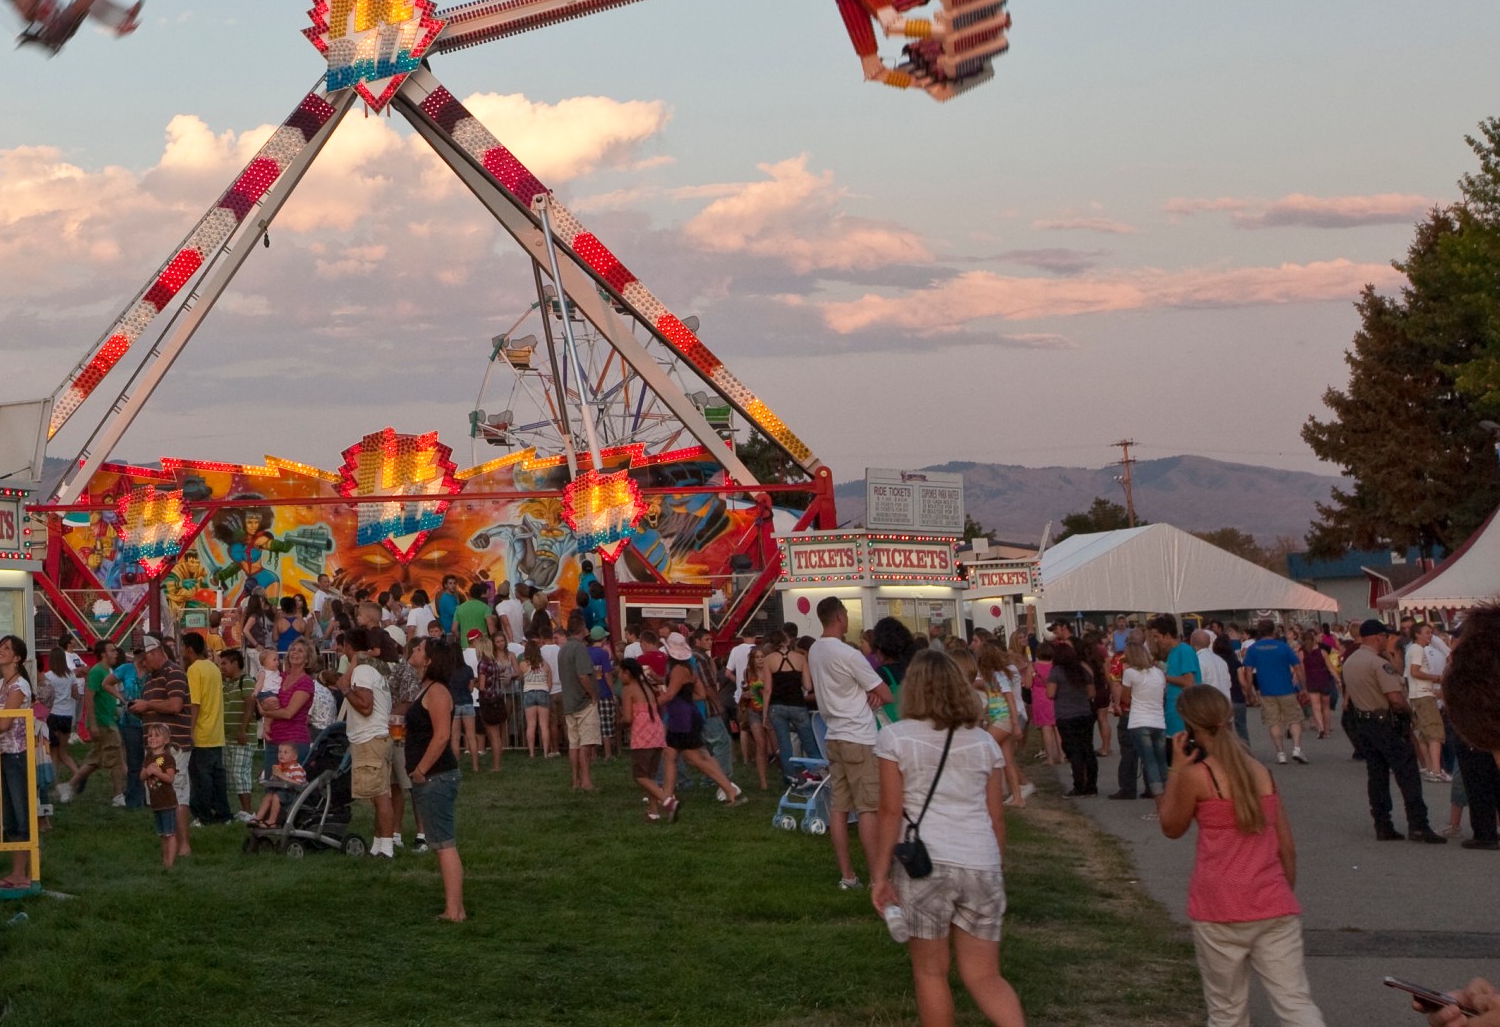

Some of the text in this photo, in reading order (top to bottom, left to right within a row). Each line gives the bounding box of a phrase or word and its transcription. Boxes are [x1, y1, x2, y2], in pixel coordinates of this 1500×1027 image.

[794, 547, 855, 570] TICKETS
[873, 547, 950, 570] TICKETS
[979, 571, 1029, 586] TICKETS
